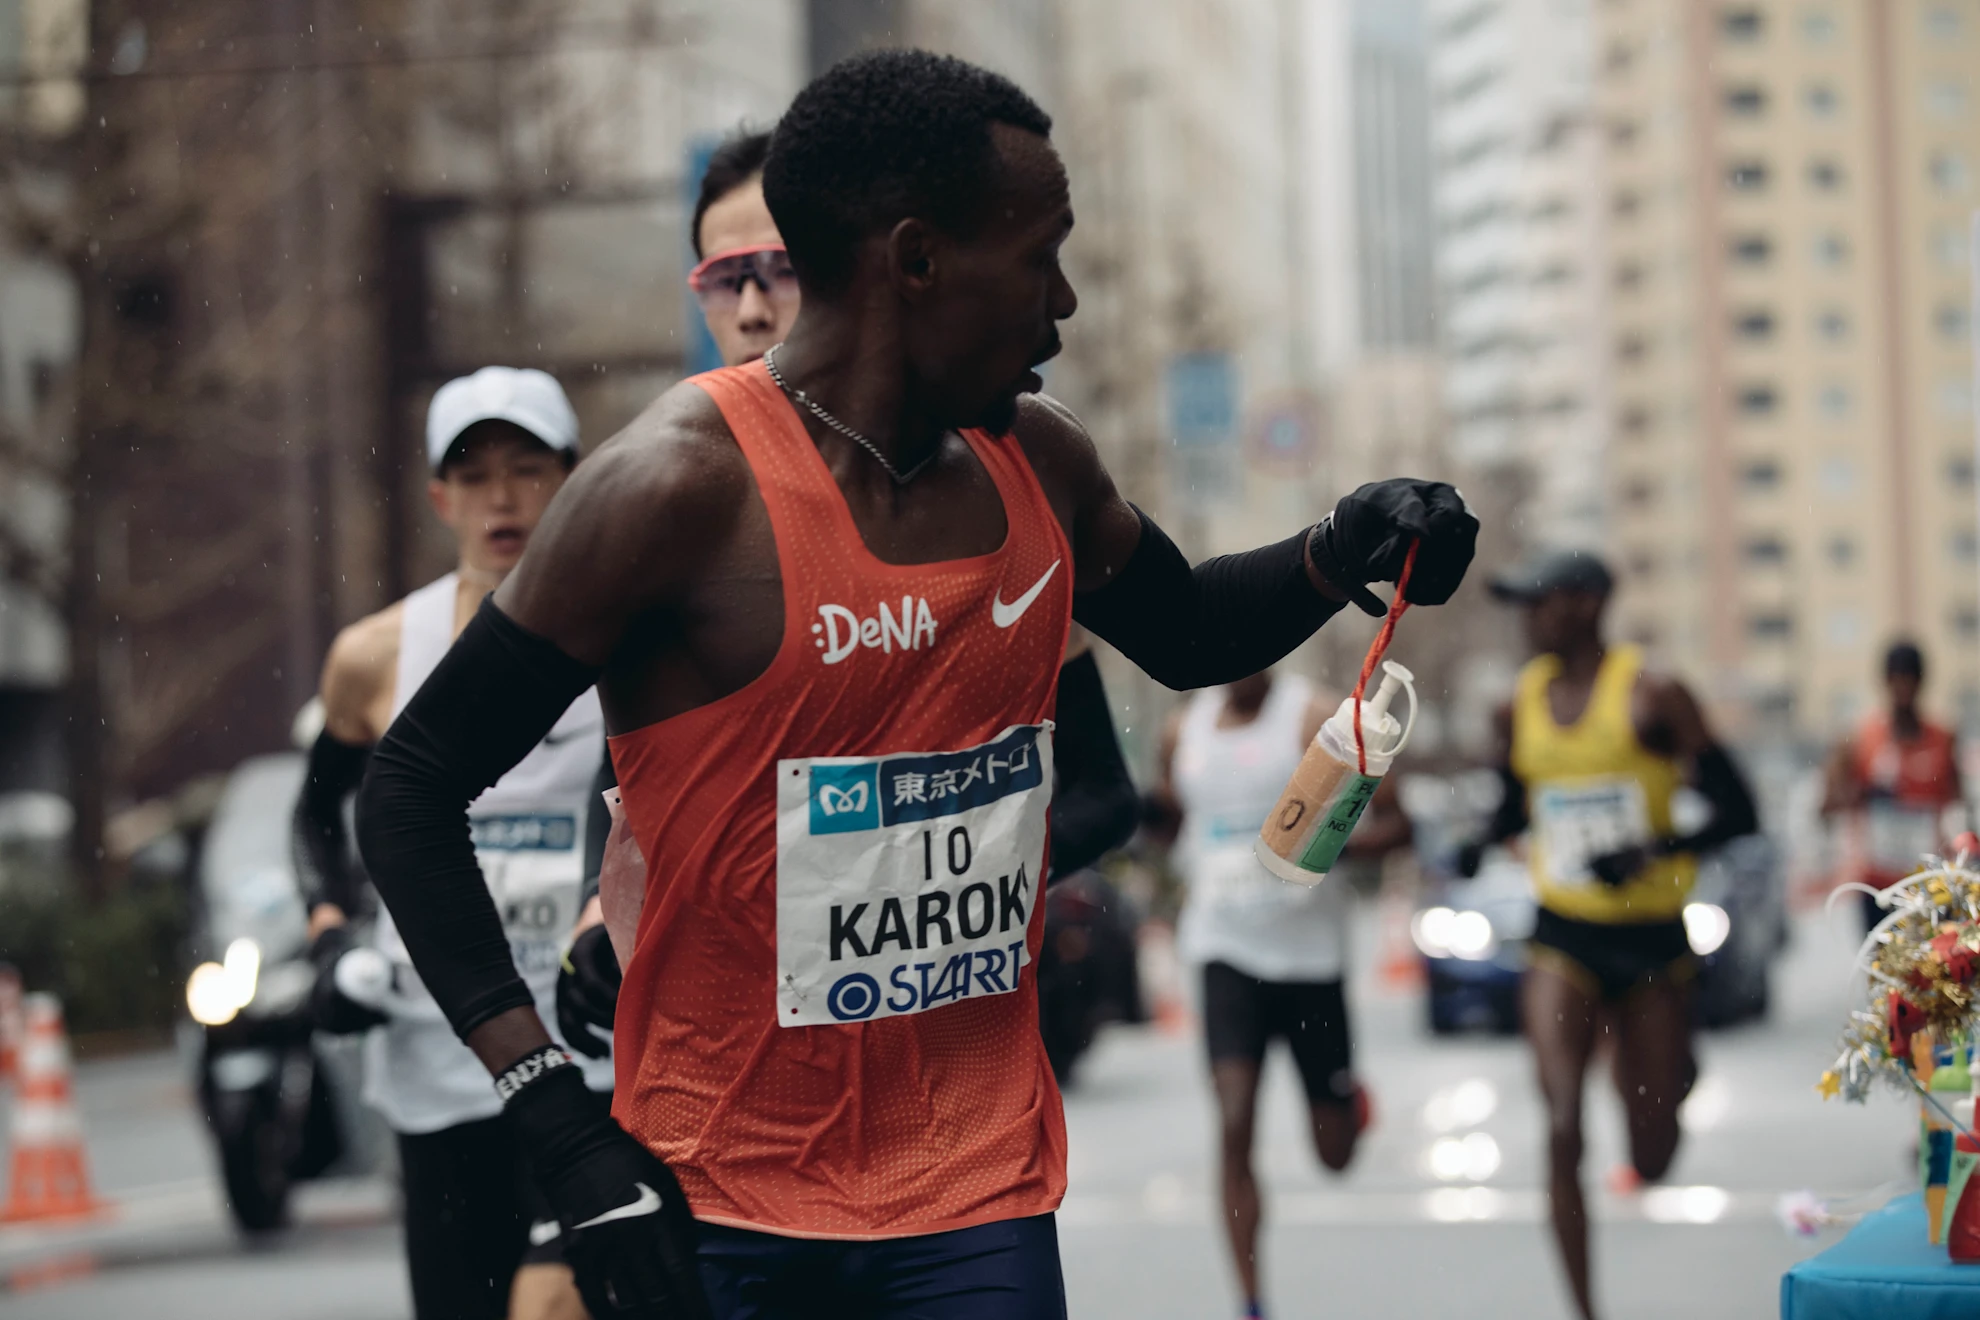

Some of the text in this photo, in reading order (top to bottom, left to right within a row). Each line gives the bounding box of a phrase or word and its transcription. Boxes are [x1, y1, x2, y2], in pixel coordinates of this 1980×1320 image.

[892, 743, 1030, 806] 東京メトロ
[924, 825, 972, 881] 10
[830, 861, 1029, 962] KAROK
